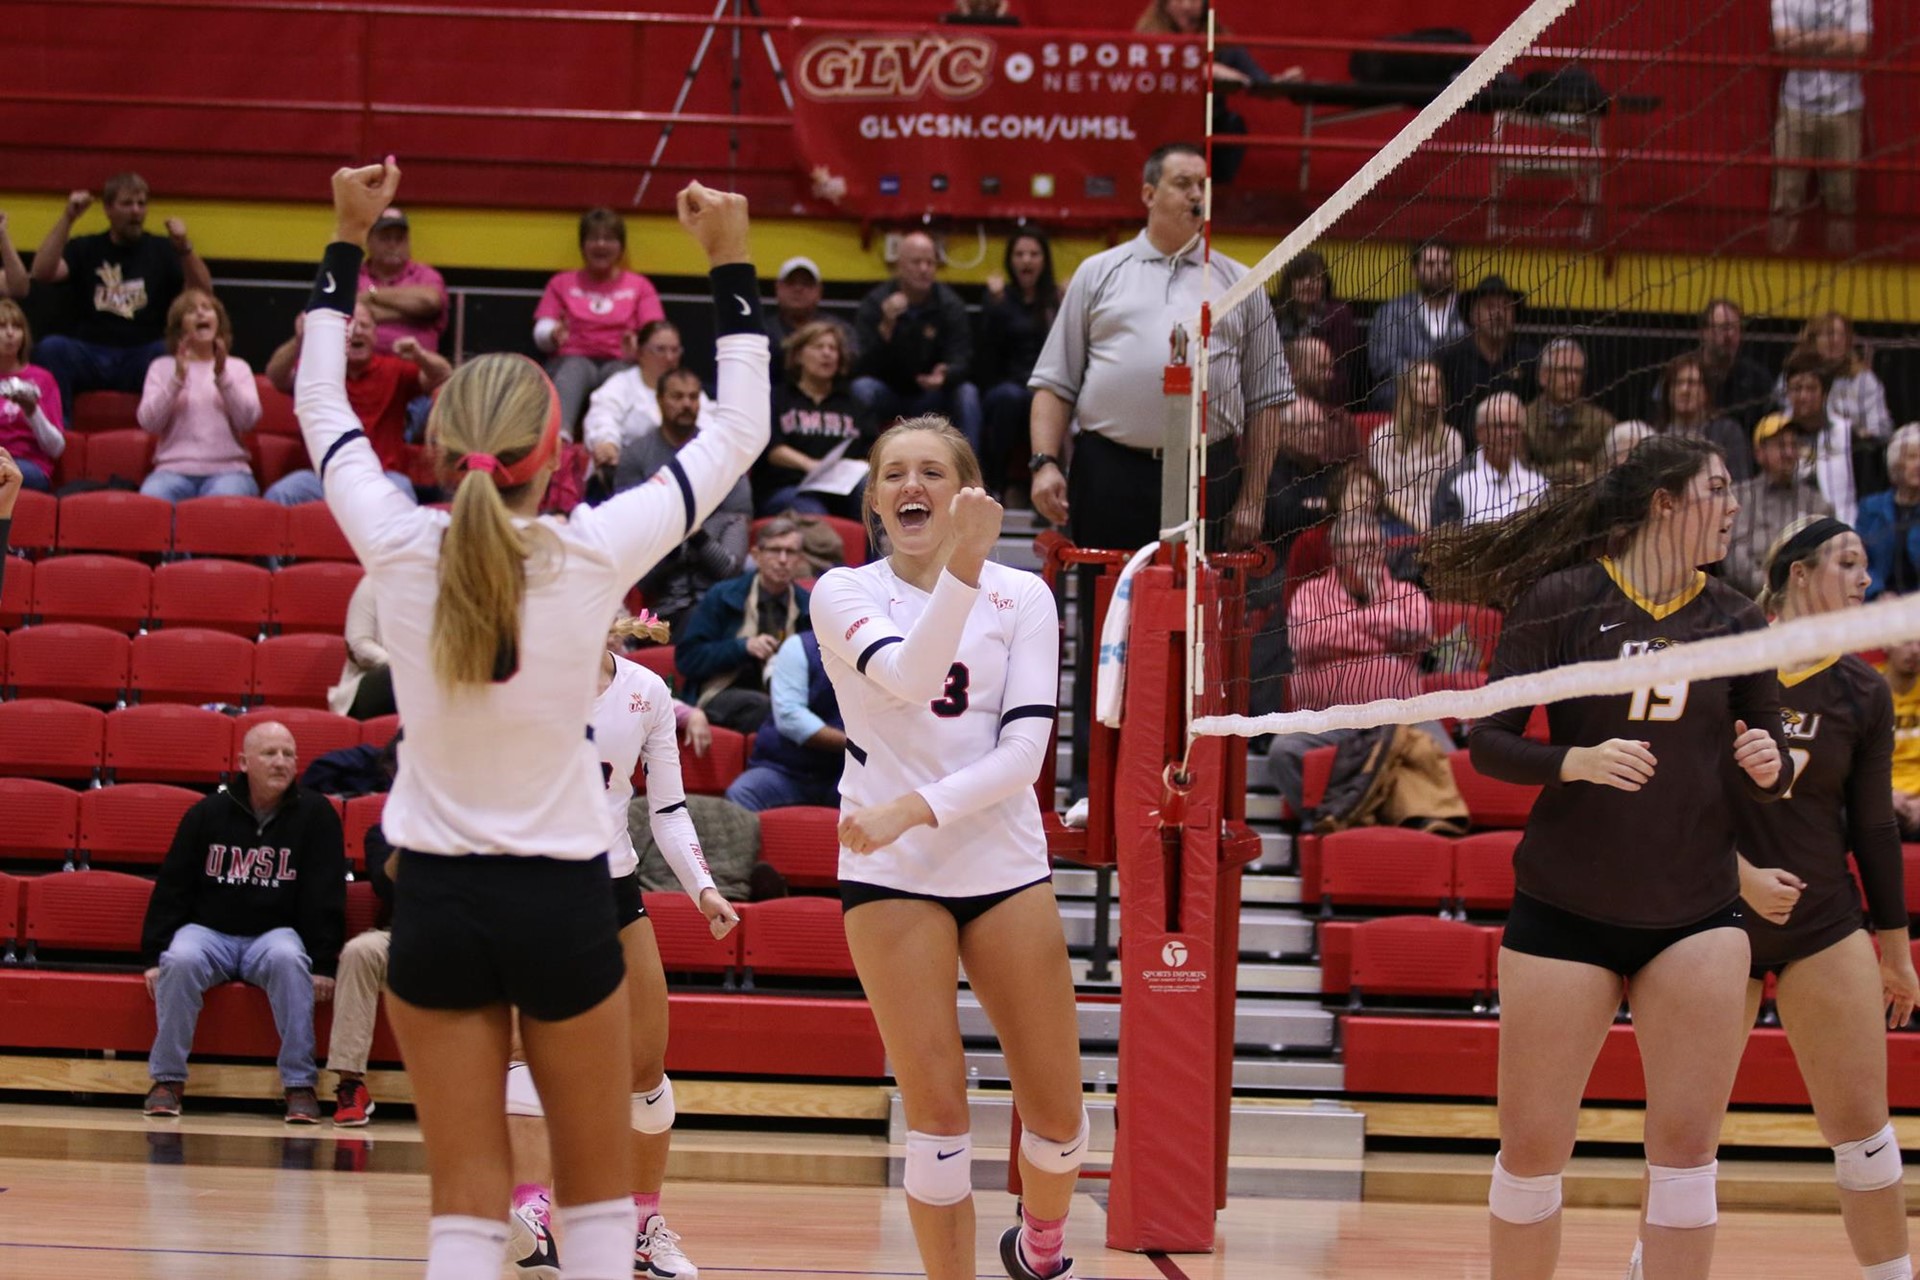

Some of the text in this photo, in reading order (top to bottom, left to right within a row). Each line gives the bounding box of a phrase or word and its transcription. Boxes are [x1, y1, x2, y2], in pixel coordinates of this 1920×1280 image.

[800, 37, 991, 96] GLVC
[1043, 43, 1200, 68] SPORTS
[1043, 72, 1199, 94] NETWORK
[860, 114, 1135, 142] GLVCSN.COM/UMSL
[931, 662, 969, 718] 3
[1628, 679, 1690, 721] 19
[205, 843, 297, 881] UMSL
